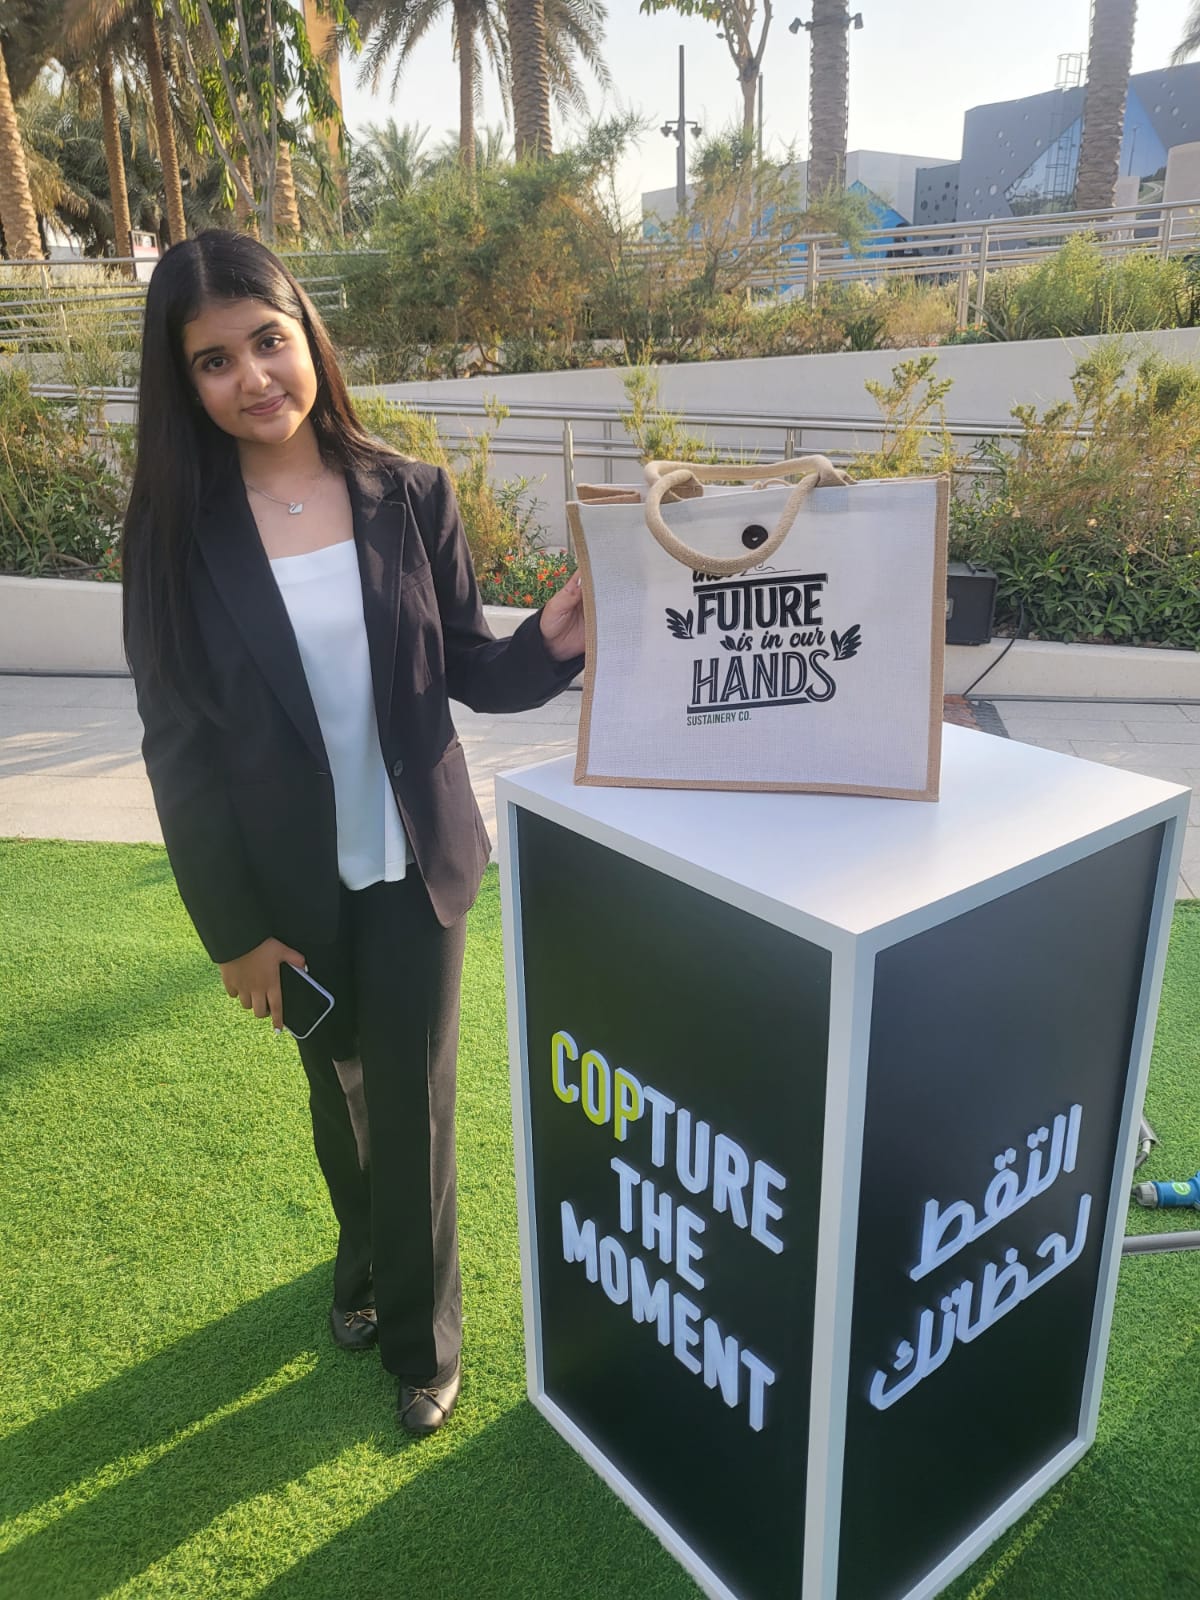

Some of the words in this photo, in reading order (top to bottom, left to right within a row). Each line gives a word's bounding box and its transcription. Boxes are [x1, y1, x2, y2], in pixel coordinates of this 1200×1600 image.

[696, 582, 824, 635] FUTURE
[735, 632, 753, 652] is
[760, 630, 783, 650] in
[789, 627, 826, 648] our
[686, 711, 737, 726] SUSTAINERY
[738, 710, 752, 722] CO.
[691, 649, 837, 704] HANDS
[551, 1030, 787, 1255] COPTURE
[909, 1103, 1083, 1282] التقط
[610, 1157, 706, 1291] THE
[560, 1200, 776, 1432] MOMENT
[869, 1193, 1092, 1411] لحظاتك
